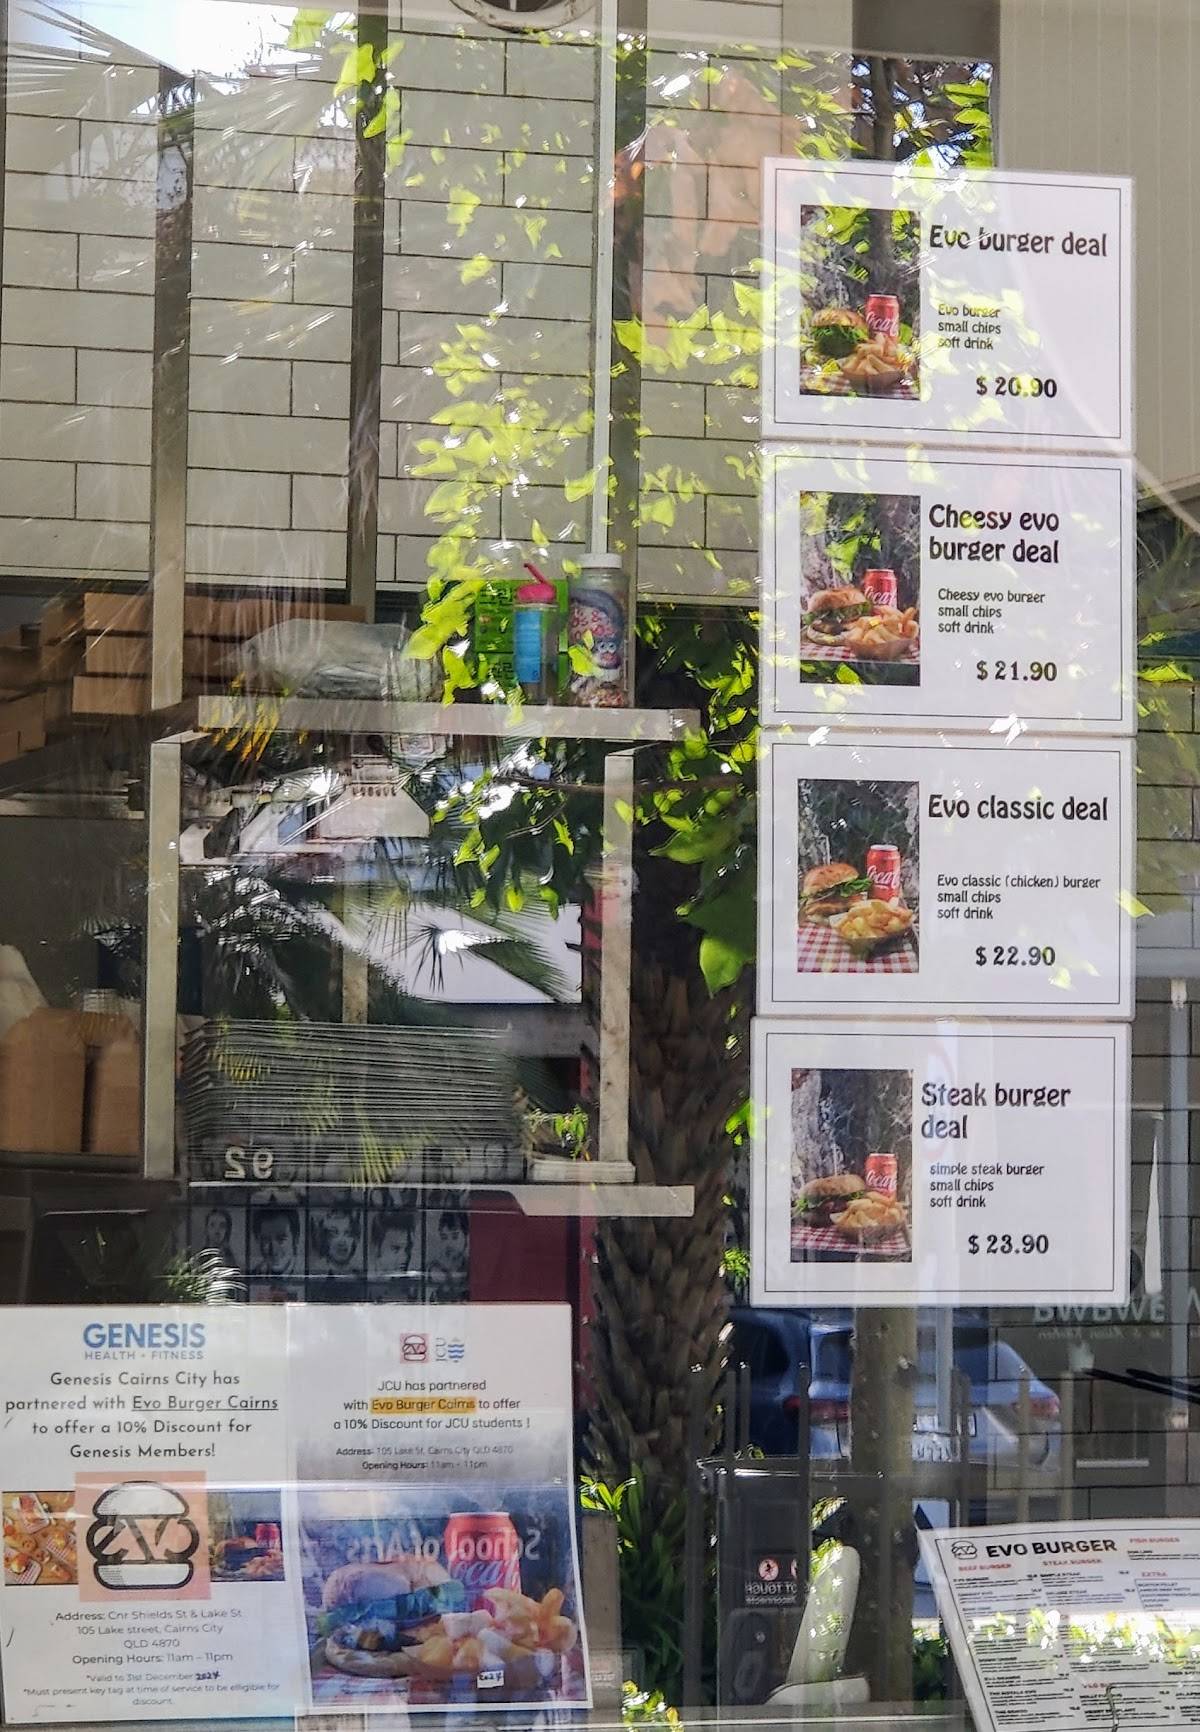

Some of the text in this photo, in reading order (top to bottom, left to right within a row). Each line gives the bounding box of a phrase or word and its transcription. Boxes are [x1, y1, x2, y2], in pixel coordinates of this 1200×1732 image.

[929, 225, 1107, 257] Evo burger deal
[938, 304, 1001, 318] Evo burger
[938, 321, 1001, 335] small chips
[938, 337, 994, 350] soft drink
[976, 377, 1057, 399] $ 20.90
[929, 504, 1060, 531] Cheesy evo
[929, 536, 1059, 564] burger deal
[938, 588, 1046, 604] Cheesy evo burger
[938, 605, 1002, 619] small chips
[938, 621, 995, 634] soft drink
[976, 661, 1057, 681] $ 21.90
[928, 794, 1108, 821] Evo classic deal
[937, 875, 958, 887] Evo
[962, 875, 1001, 887] classic
[1063, 875, 1101, 889] burger
[937, 891, 1001, 904] small chips
[937, 907, 993, 920] soft drink
[975, 946, 1055, 967] $ 22.90
[921, 1083, 1071, 1108] Steak burger
[921, 1115, 968, 1139] deal
[930, 1163, 1045, 1177] simple steak burger
[930, 1179, 994, 1193] small chips
[930, 1195, 986, 1208] soft drink
[968, 1234, 1049, 1255] $ 23.90
[83, 1322, 206, 1349] GENESIS
[84, 1351, 204, 1360] HEALTH FITNESS
[50, 1371, 240, 1388] Genesis Cairns City has
[378, 1380, 486, 1393] JCU has partnered
[5, 1396, 279, 1414] partnered with Evo Burger Cairns
[344, 1399, 520, 1413] with Evo Burger Cairns to offer
[32, 1418, 252, 1435] to offer a 10% Discount for
[334, 1421, 341, 1429] a
[344, 1419, 368, 1430] 10%
[372, 1418, 422, 1429] Discount
[426, 1418, 441, 1429] for
[445, 1418, 469, 1428] JCU
[472, 1418, 523, 1428] students
[70, 1443, 216, 1458] Genesis Members!
[362, 1461, 398, 1471] Opening
[430, 1460, 454, 1469] 11am
[463, 1460, 487, 1471] 11pm
[986, 1544, 1028, 1558] EVO
[1032, 1539, 1117, 1555] BURGER
[55, 1608, 242, 1622] Address: Cnr Shields St & Lake St
[77, 1625, 95, 1635] 105
[98, 1625, 124, 1635] Lake
[164, 1624, 199, 1634] Cairns
[202, 1623, 223, 1635] City
[123, 1638, 180, 1649] QLD 4870
[72, 1652, 233, 1667] Opening Hours: 11am 11pm
[146, 1672, 194, 1681] December
[52, 1686, 88, 1697] present
[90, 1686, 105, 1697] key
[108, 1686, 124, 1696] tag
[172, 1685, 204, 1693] service
